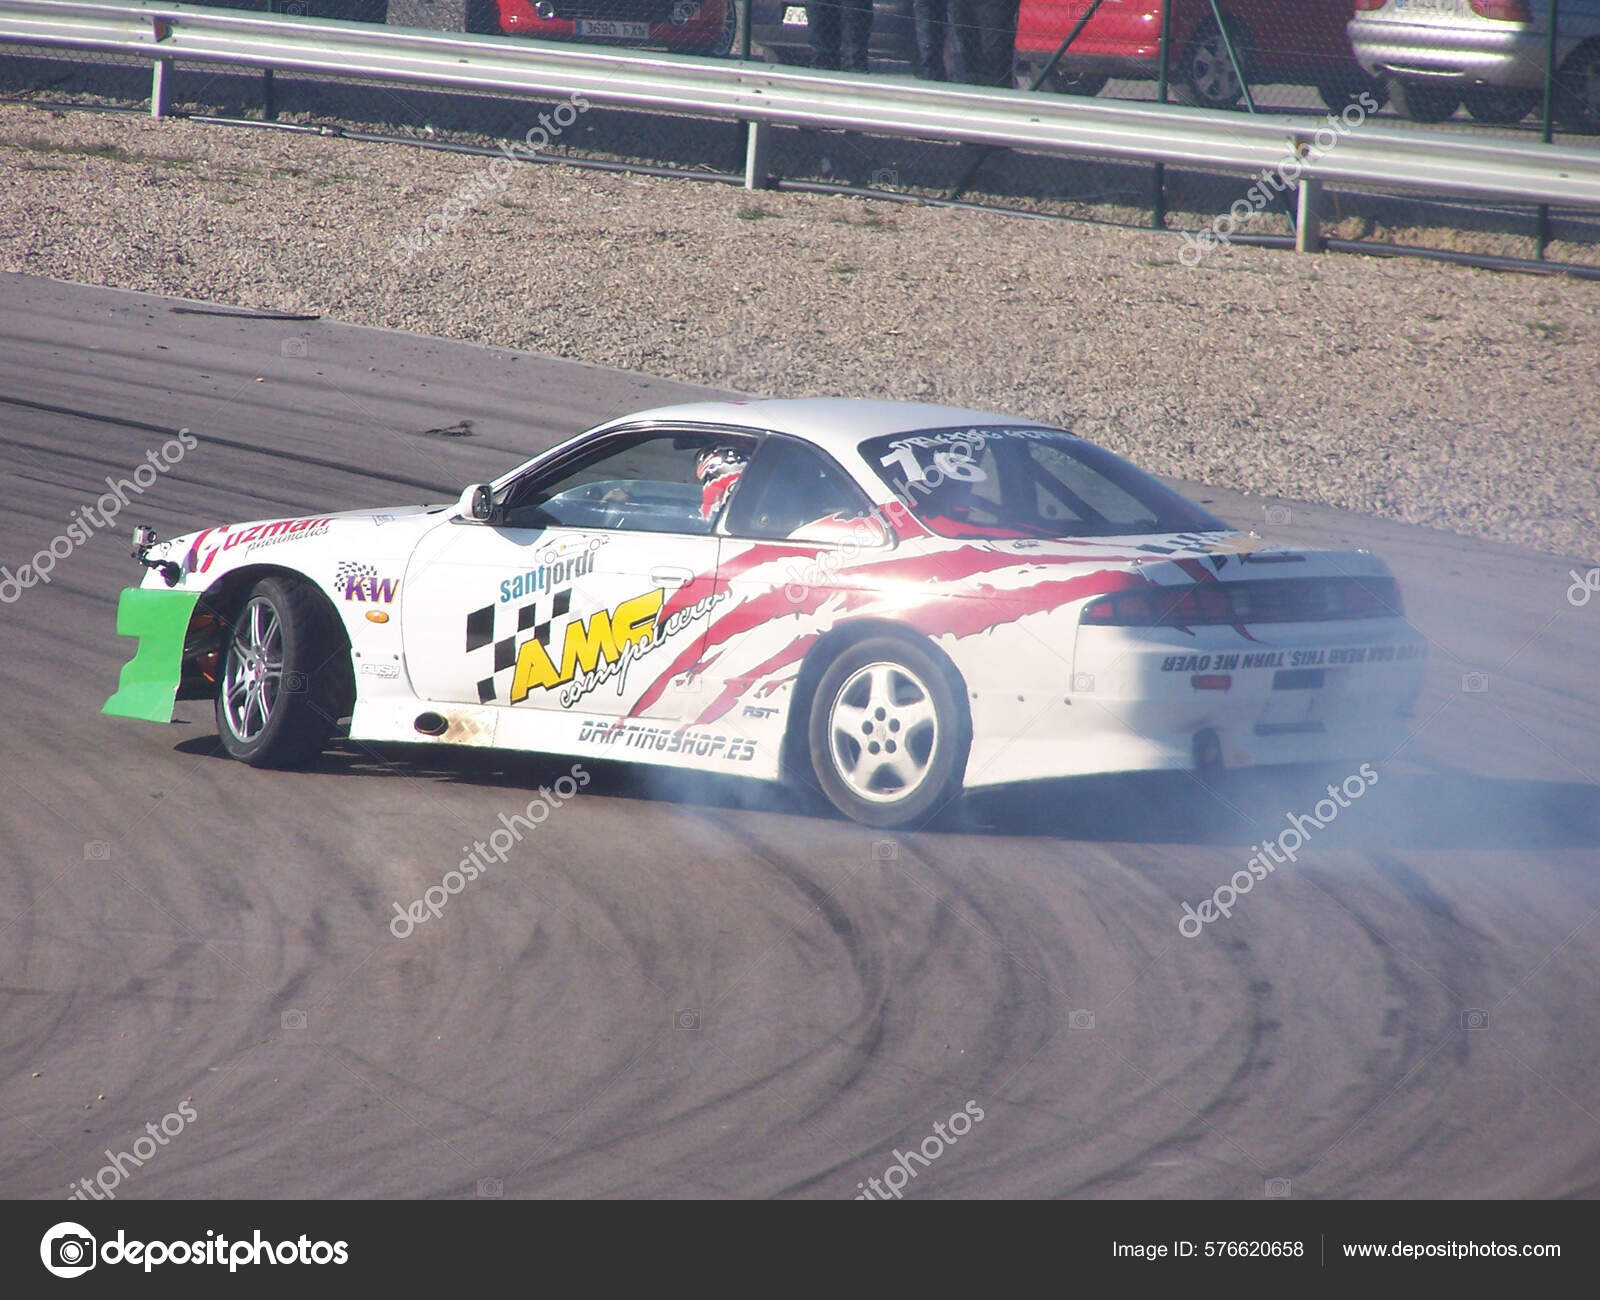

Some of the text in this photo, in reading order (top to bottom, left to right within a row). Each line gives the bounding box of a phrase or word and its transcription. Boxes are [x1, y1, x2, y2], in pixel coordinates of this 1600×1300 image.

[500, 550, 595, 603] santjordi
[345, 575, 400, 604] KW
[1161, 655, 1211, 672] OVER
[1213, 654, 1239, 671] ME
[1240, 652, 1285, 670] TURN
